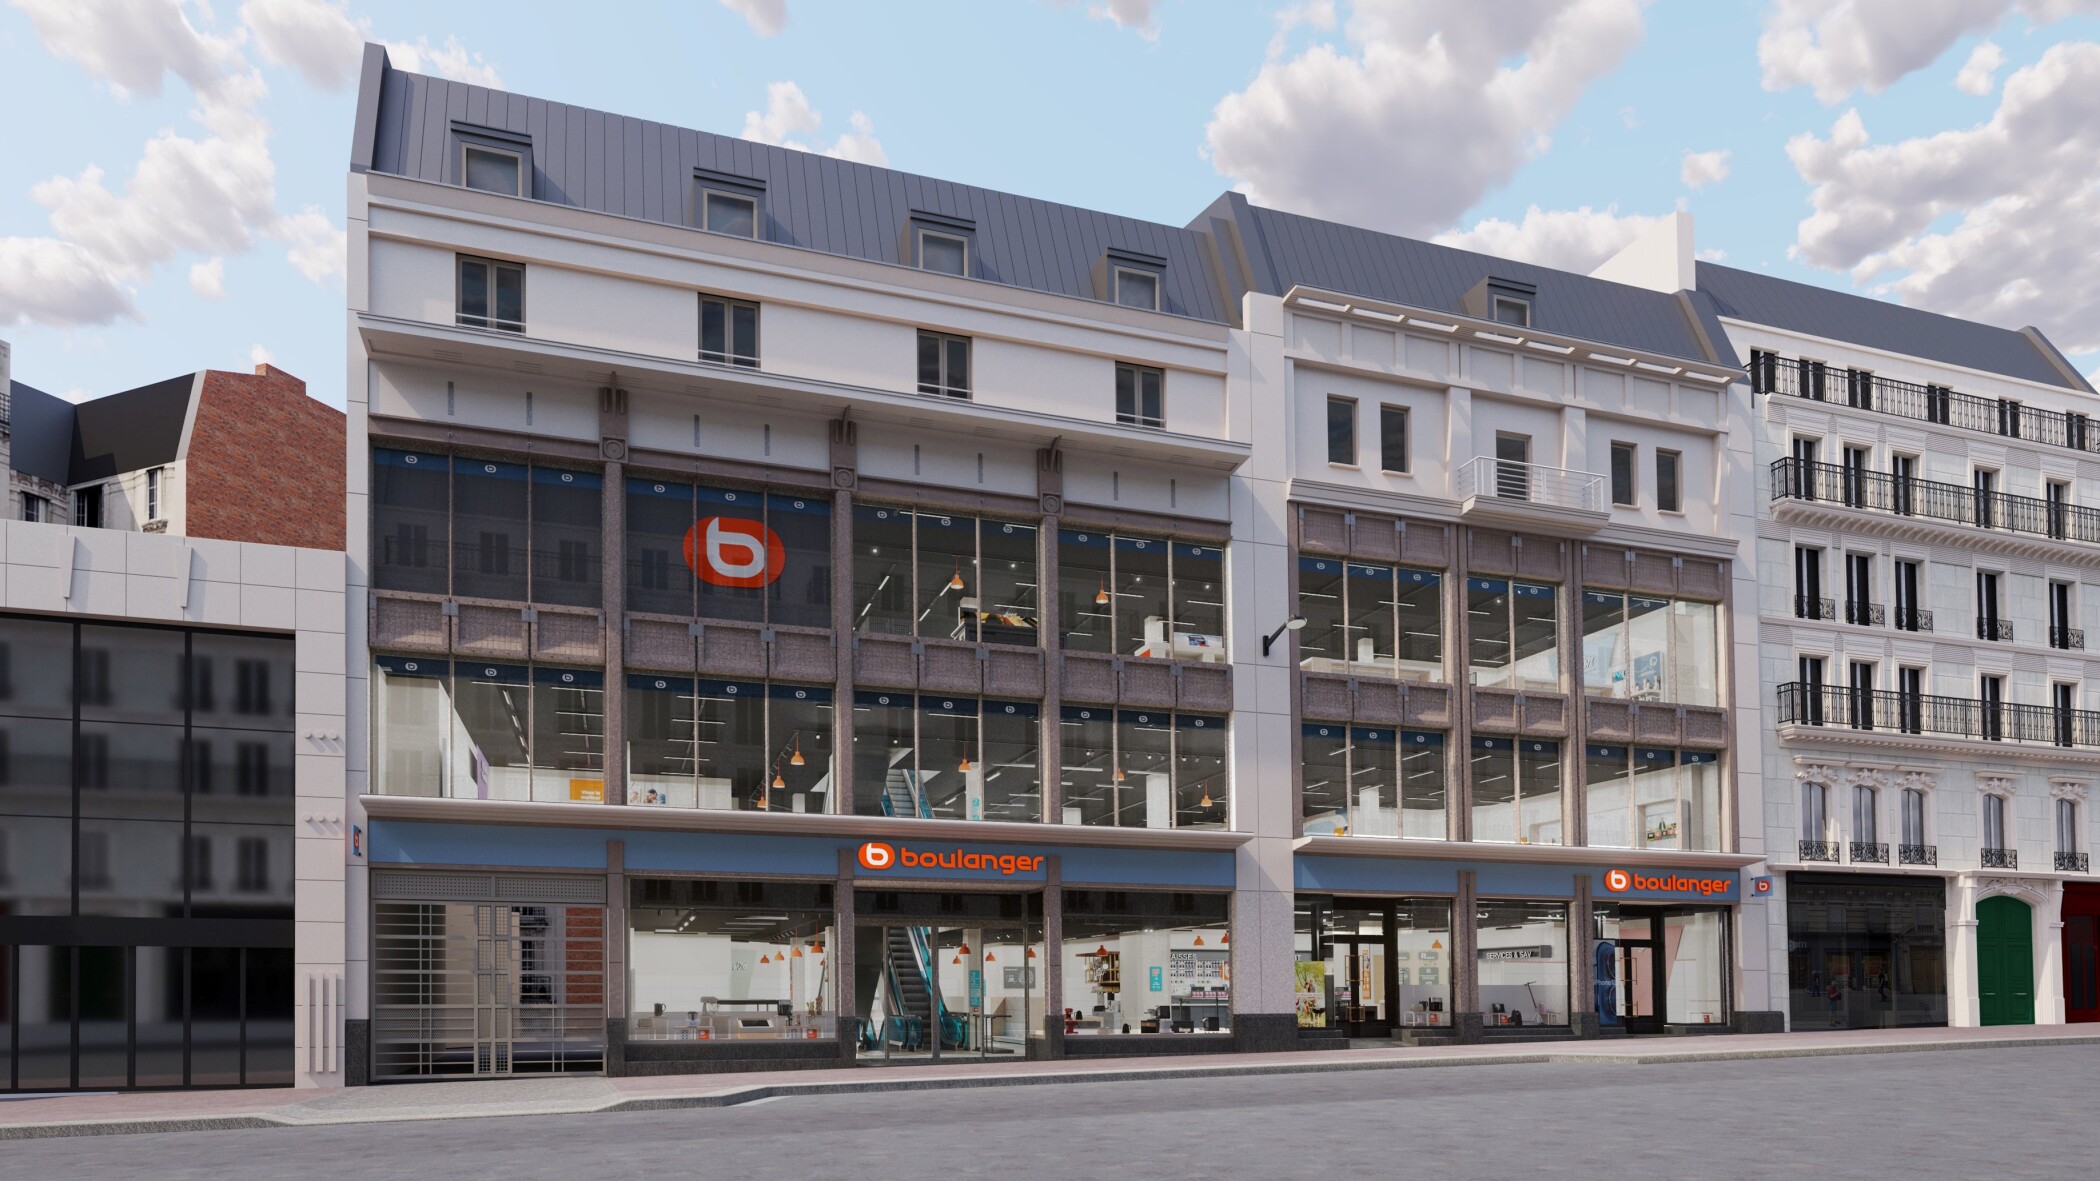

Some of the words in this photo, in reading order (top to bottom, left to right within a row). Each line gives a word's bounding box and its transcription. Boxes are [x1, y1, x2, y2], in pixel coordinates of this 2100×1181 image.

[706, 516, 764, 578] b
[866, 842, 889, 866] b
[901, 847, 1044, 875] boulanger
[1611, 870, 1627, 889] b
[1633, 873, 1732, 896] boulanger
[1486, 951, 1512, 960] SERVICES
